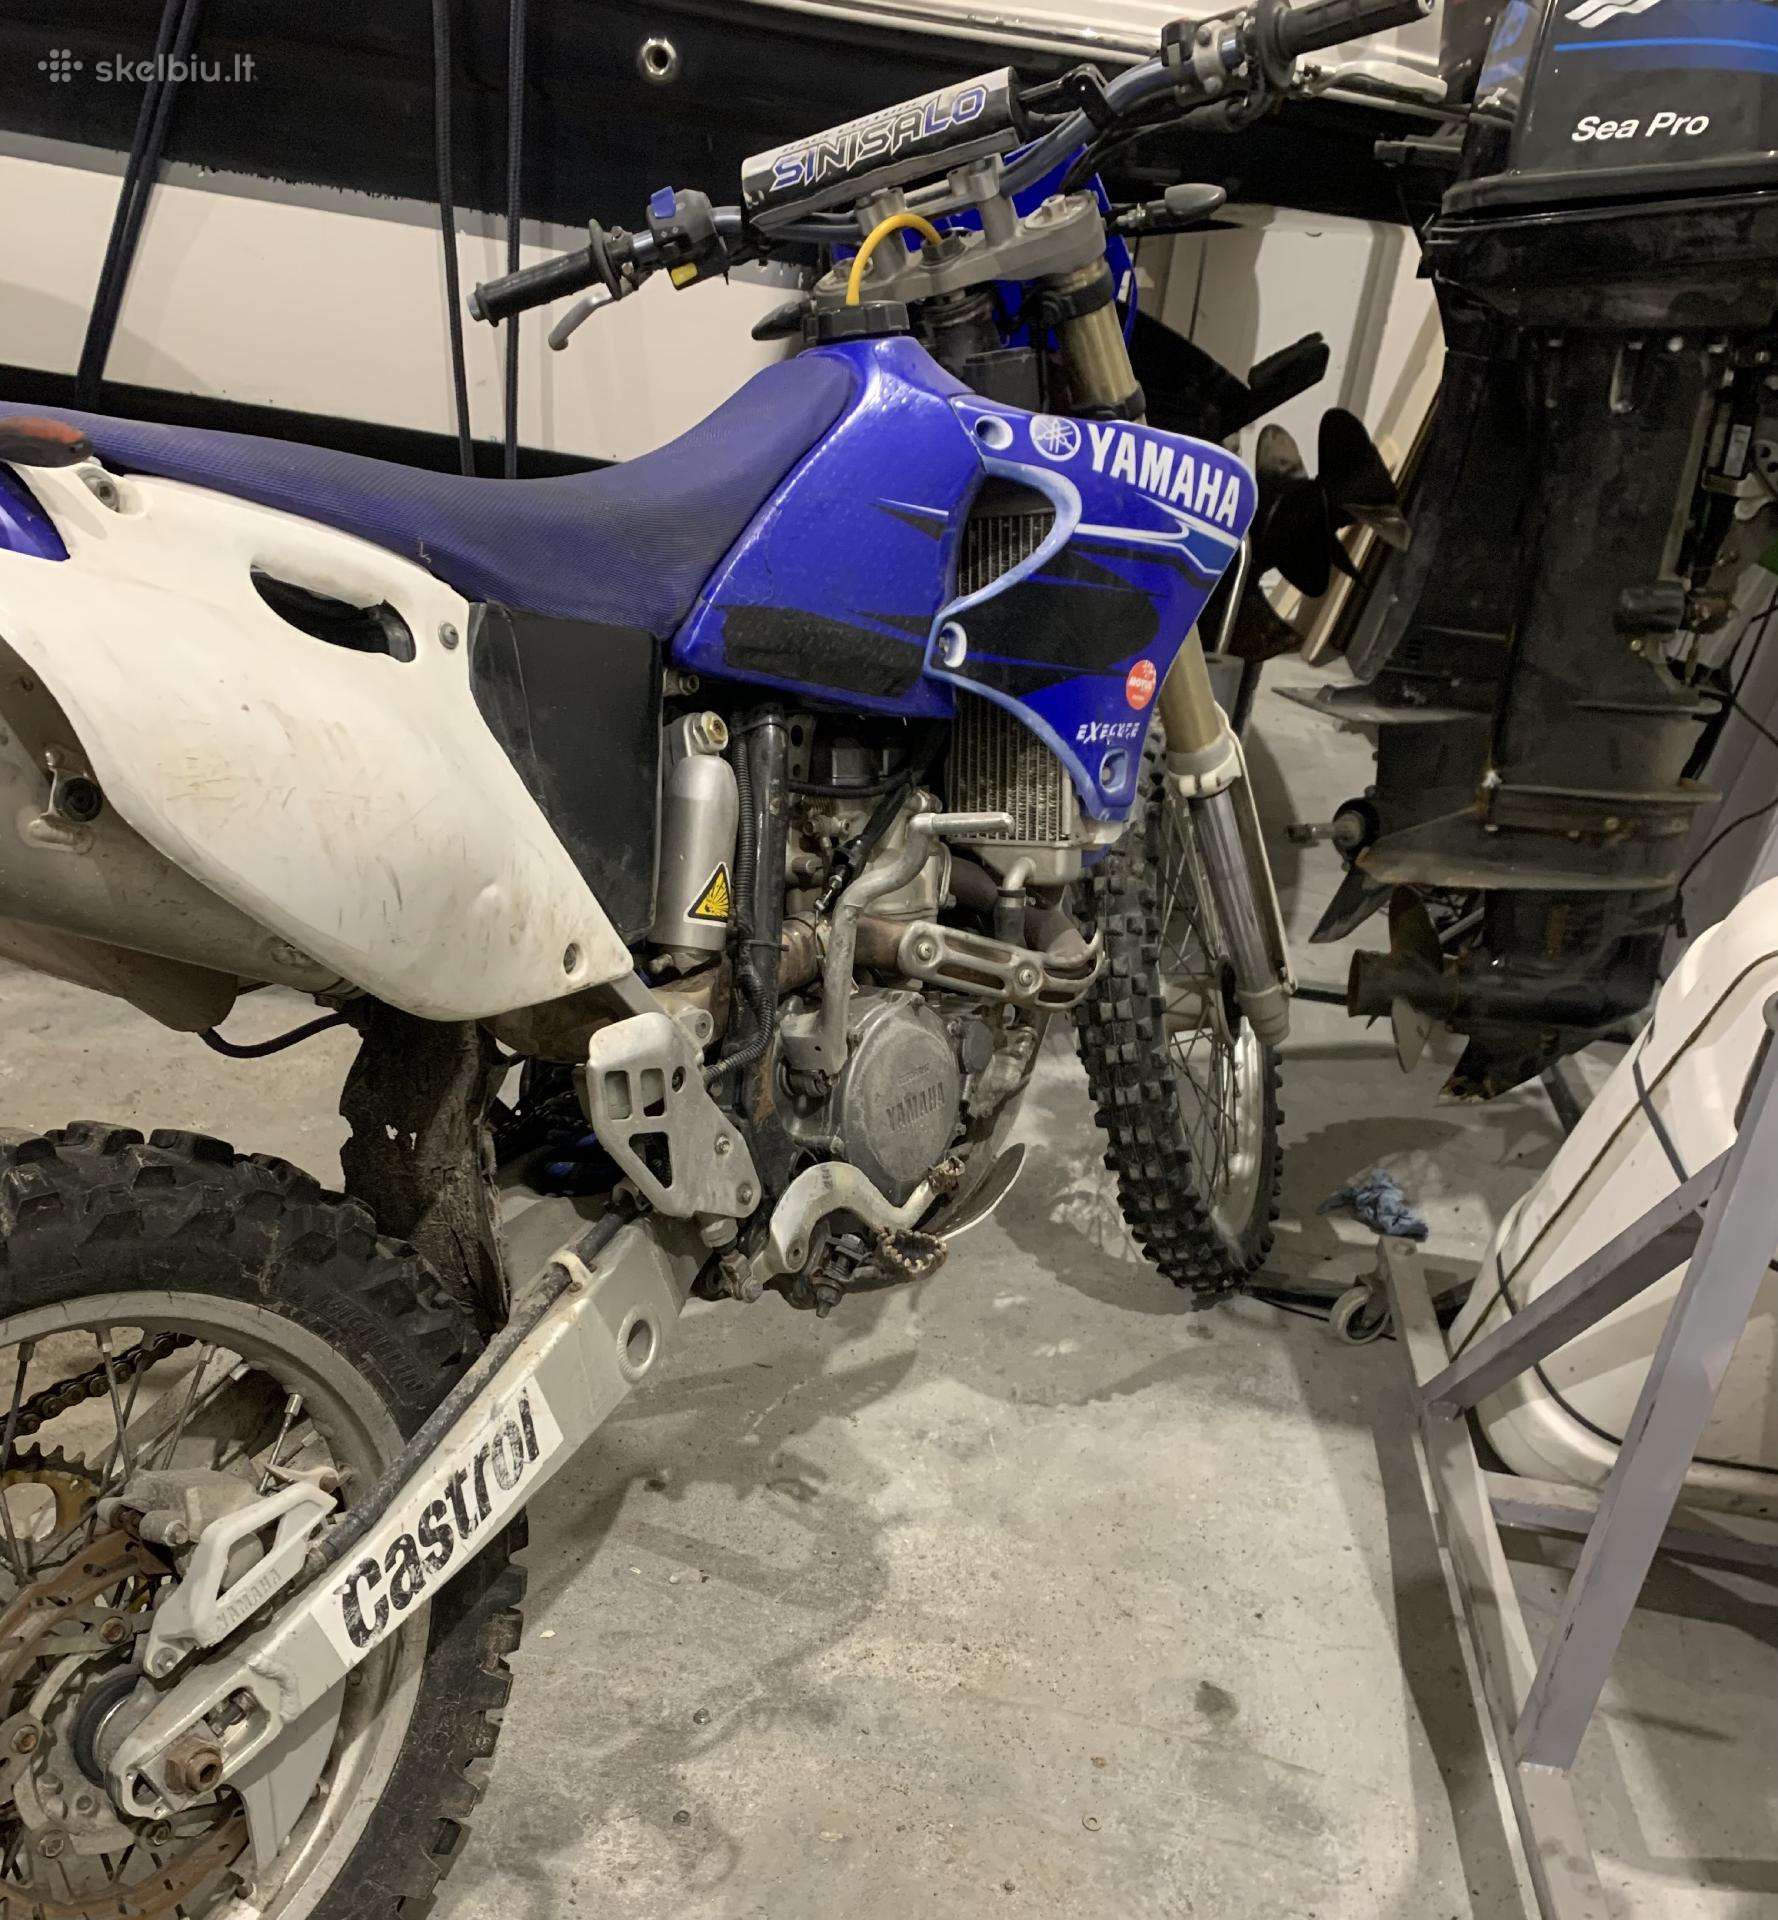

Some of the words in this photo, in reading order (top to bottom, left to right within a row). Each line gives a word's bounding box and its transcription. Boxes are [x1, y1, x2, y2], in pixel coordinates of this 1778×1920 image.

[769, 84, 989, 191] SINISALO
[1571, 115, 1640, 142] Sea
[1645, 111, 1710, 137] Pro
[1087, 422, 1241, 528] YAMAHA
[886, 1081, 945, 1131] YAMAHA
[341, 1387, 540, 1648] Castrol
[216, 1567, 283, 1629] YAMAHA
